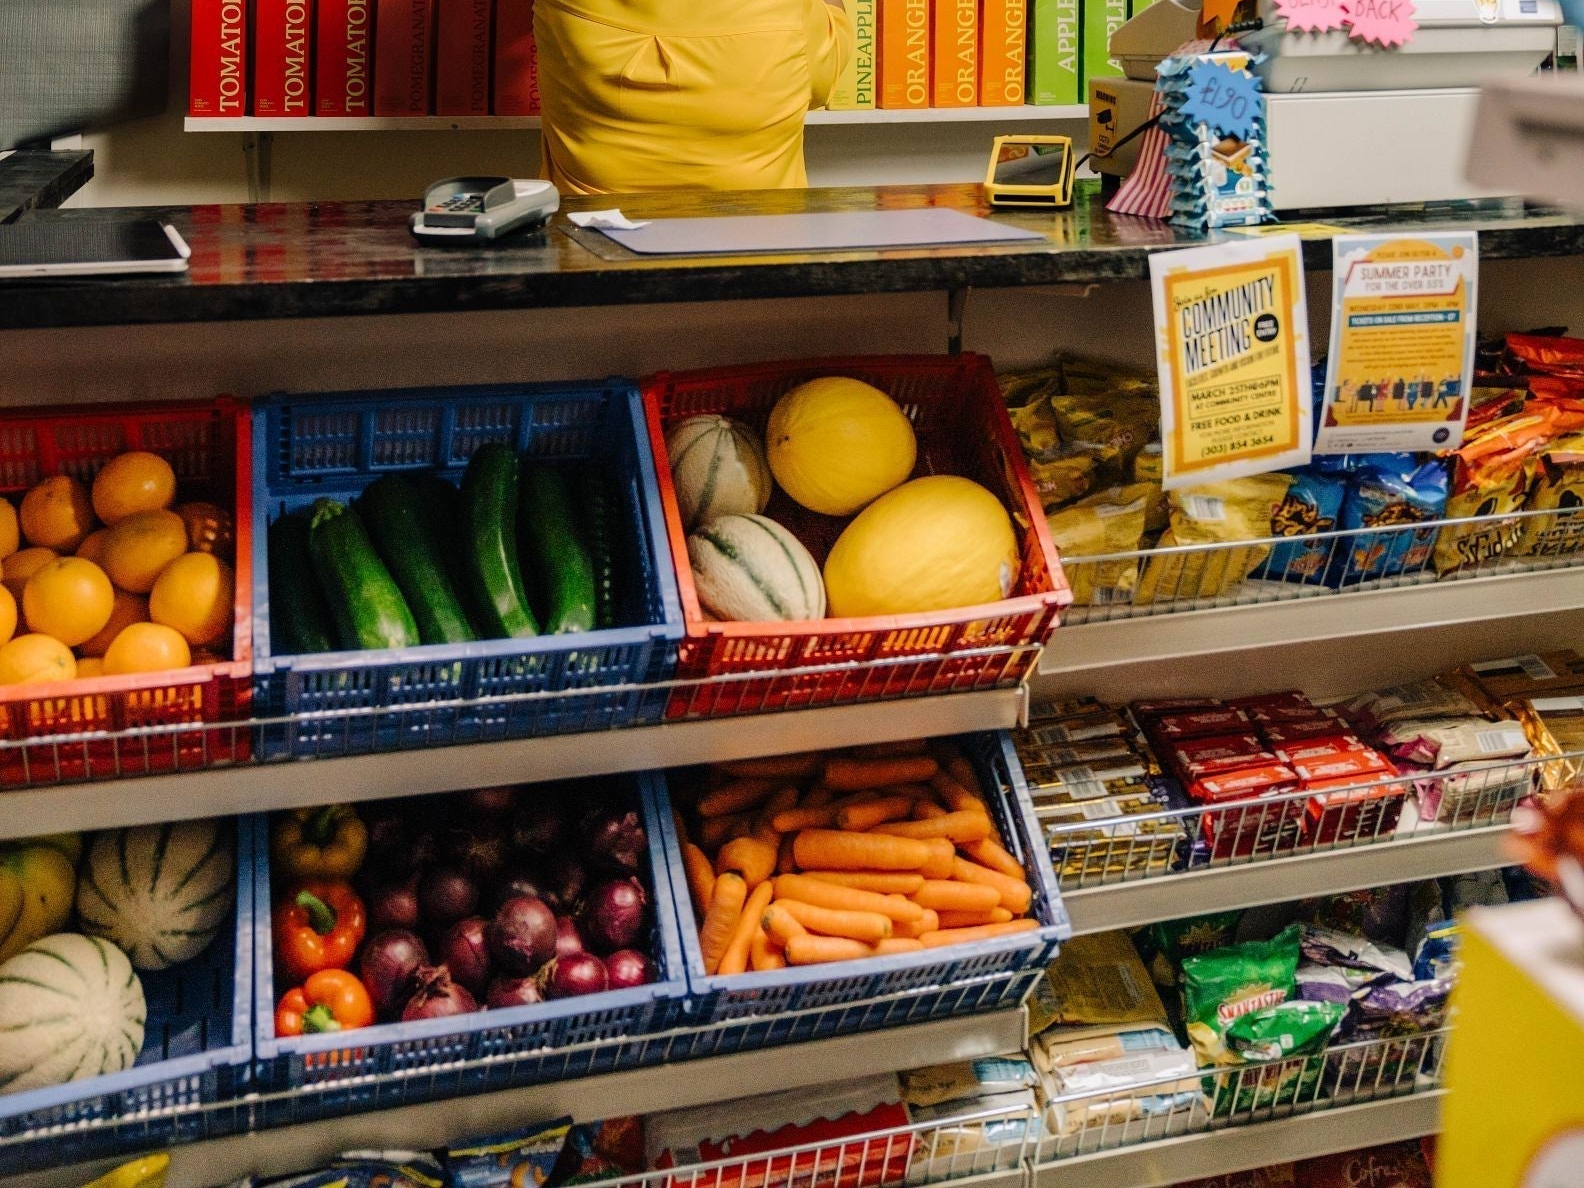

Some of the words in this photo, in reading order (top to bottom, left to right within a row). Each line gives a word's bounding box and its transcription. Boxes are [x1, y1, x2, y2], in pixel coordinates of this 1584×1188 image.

[1200, 76, 1247, 120] £1.90
[1360, 266, 1409, 280] SUMMER
[1414, 264, 1452, 277] PARTY
[1365, 282, 1381, 291] FOR
[1384, 281, 1399, 290] THE
[1401, 280, 1422, 289] OVER
[1183, 274, 1274, 338] COMMUNITY
[1185, 319, 1251, 373] MEETING
[1192, 388, 1226, 401] MARCH
[1206, 395, 1248, 408] COMMUNITY
[1251, 390, 1276, 399] CENTRE
[1191, 419, 1212, 431] FREE
[1215, 415, 1241, 426] FOOD
[1253, 407, 1281, 419] DRINK
[1201, 444, 1227, 457] (303)
[1251, 435, 1273, 446] 3654
